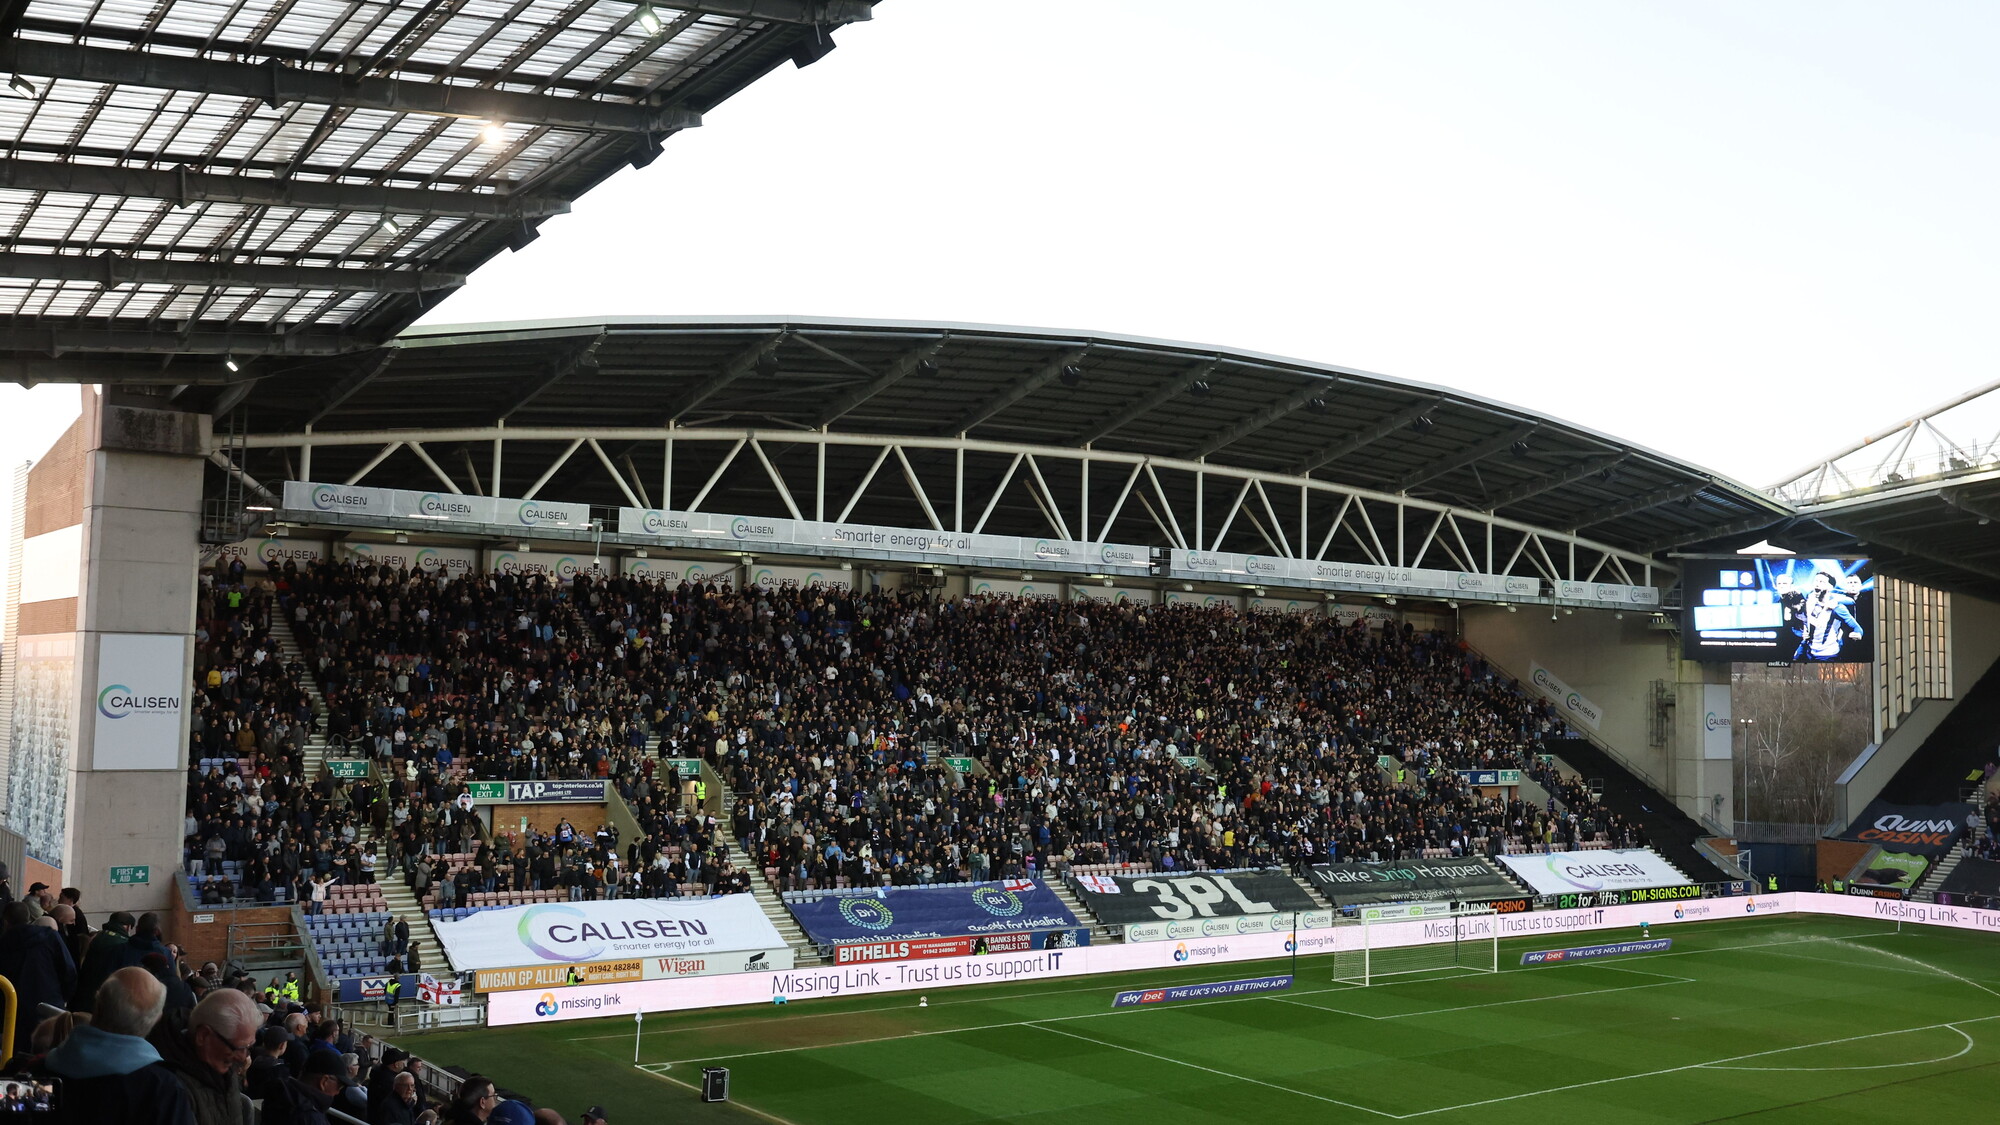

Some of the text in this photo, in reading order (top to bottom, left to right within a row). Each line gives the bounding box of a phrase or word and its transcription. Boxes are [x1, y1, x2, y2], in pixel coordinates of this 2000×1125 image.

[320, 494, 367, 505] CALISEN
[427, 502, 470, 513] CALISEN
[526, 510, 567, 520] CALISEN
[650, 519, 688, 529] CALISEN
[738, 525, 773, 534] CALISEN
[835, 529, 970, 550] Smarter energy for all
[200, 544, 248, 556] AISEN
[267, 548, 318, 560] CALISEN
[1040, 546, 1069, 555] CALISEN
[1106, 551, 1133, 560] CALISEN
[424, 557, 470, 568] CALISEN
[503, 562, 547, 573] CALISEN
[1191, 558, 1217, 566] CALISEN
[1250, 562, 1275, 571] CALISEN
[564, 566, 606, 577] CALISEN
[637, 570, 678, 580] CALISEN
[1317, 565, 1411, 582] Smarter energy for all
[693, 573, 731, 583] CALISEN
[762, 577, 799, 587] CALISEN
[1461, 579, 1483, 587] CALISEN
[1508, 582, 1529, 590] CALISEN
[1335, 610, 1359, 618] CALISEN
[1537, 674, 1563, 696] CALISEN
[111, 696, 179, 709] CALISEN
[1571, 698, 1596, 720] CALISEN
[511, 782, 545, 800] TAP
[1873, 814, 1958, 832] QUINN
[117, 868, 134, 876] FIRST
[1314, 869, 1373, 883] Make
[1412, 864, 1488, 879] Happen
[1566, 863, 1646, 878] CALISEN
[1132, 876, 1278, 920] 3PL
[1632, 886, 1700, 901] DM-SIGNS.COM
[987, 896, 1007, 904] BH
[1560, 894, 1577, 908] ac
[855, 909, 877, 917] BH
[1874, 901, 1925, 922] Missing
[1930, 906, 1958, 923] Link
[968, 916, 1068, 932] Breath for Healing
[1425, 910, 1604, 940] Missing Link Trust us to support IT
[548, 919, 708, 943] CALISEN
[1134, 929, 1159, 937] CALISEN
[1171, 926, 1194, 934] CALISEN
[613, 937, 715, 951] Smarter energy for all
[992, 936, 1011, 944] BANKS
[1017, 934, 1030, 942] SON
[1300, 936, 1334, 947] missing link
[839, 942, 909, 962] BITHELLS
[988, 942, 1030, 952] UNERALS LTD.
[1190, 944, 1228, 956] missing link
[1528, 953, 1545, 961] sky
[1622, 944, 1650, 952] BETTING
[589, 963, 640, 973] 01942 482848
[658, 956, 706, 975] Wigan
[745, 961, 770, 971] CARLING
[772, 974, 840, 994] Missing
[846, 968, 880, 988] Link
[897, 965, 939, 983] Trust
[944, 964, 962, 980] us
[967, 961, 981, 978] to
[986, 956, 1043, 979] support
[1048, 952, 1063, 970] IT
[479, 971, 516, 989] WIGAN
[519, 970, 532, 985] GP
[1121, 979, 1287, 1003] sky bet THE UK'S NO.1 BETTING APP
[562, 993, 621, 1009] missing link
